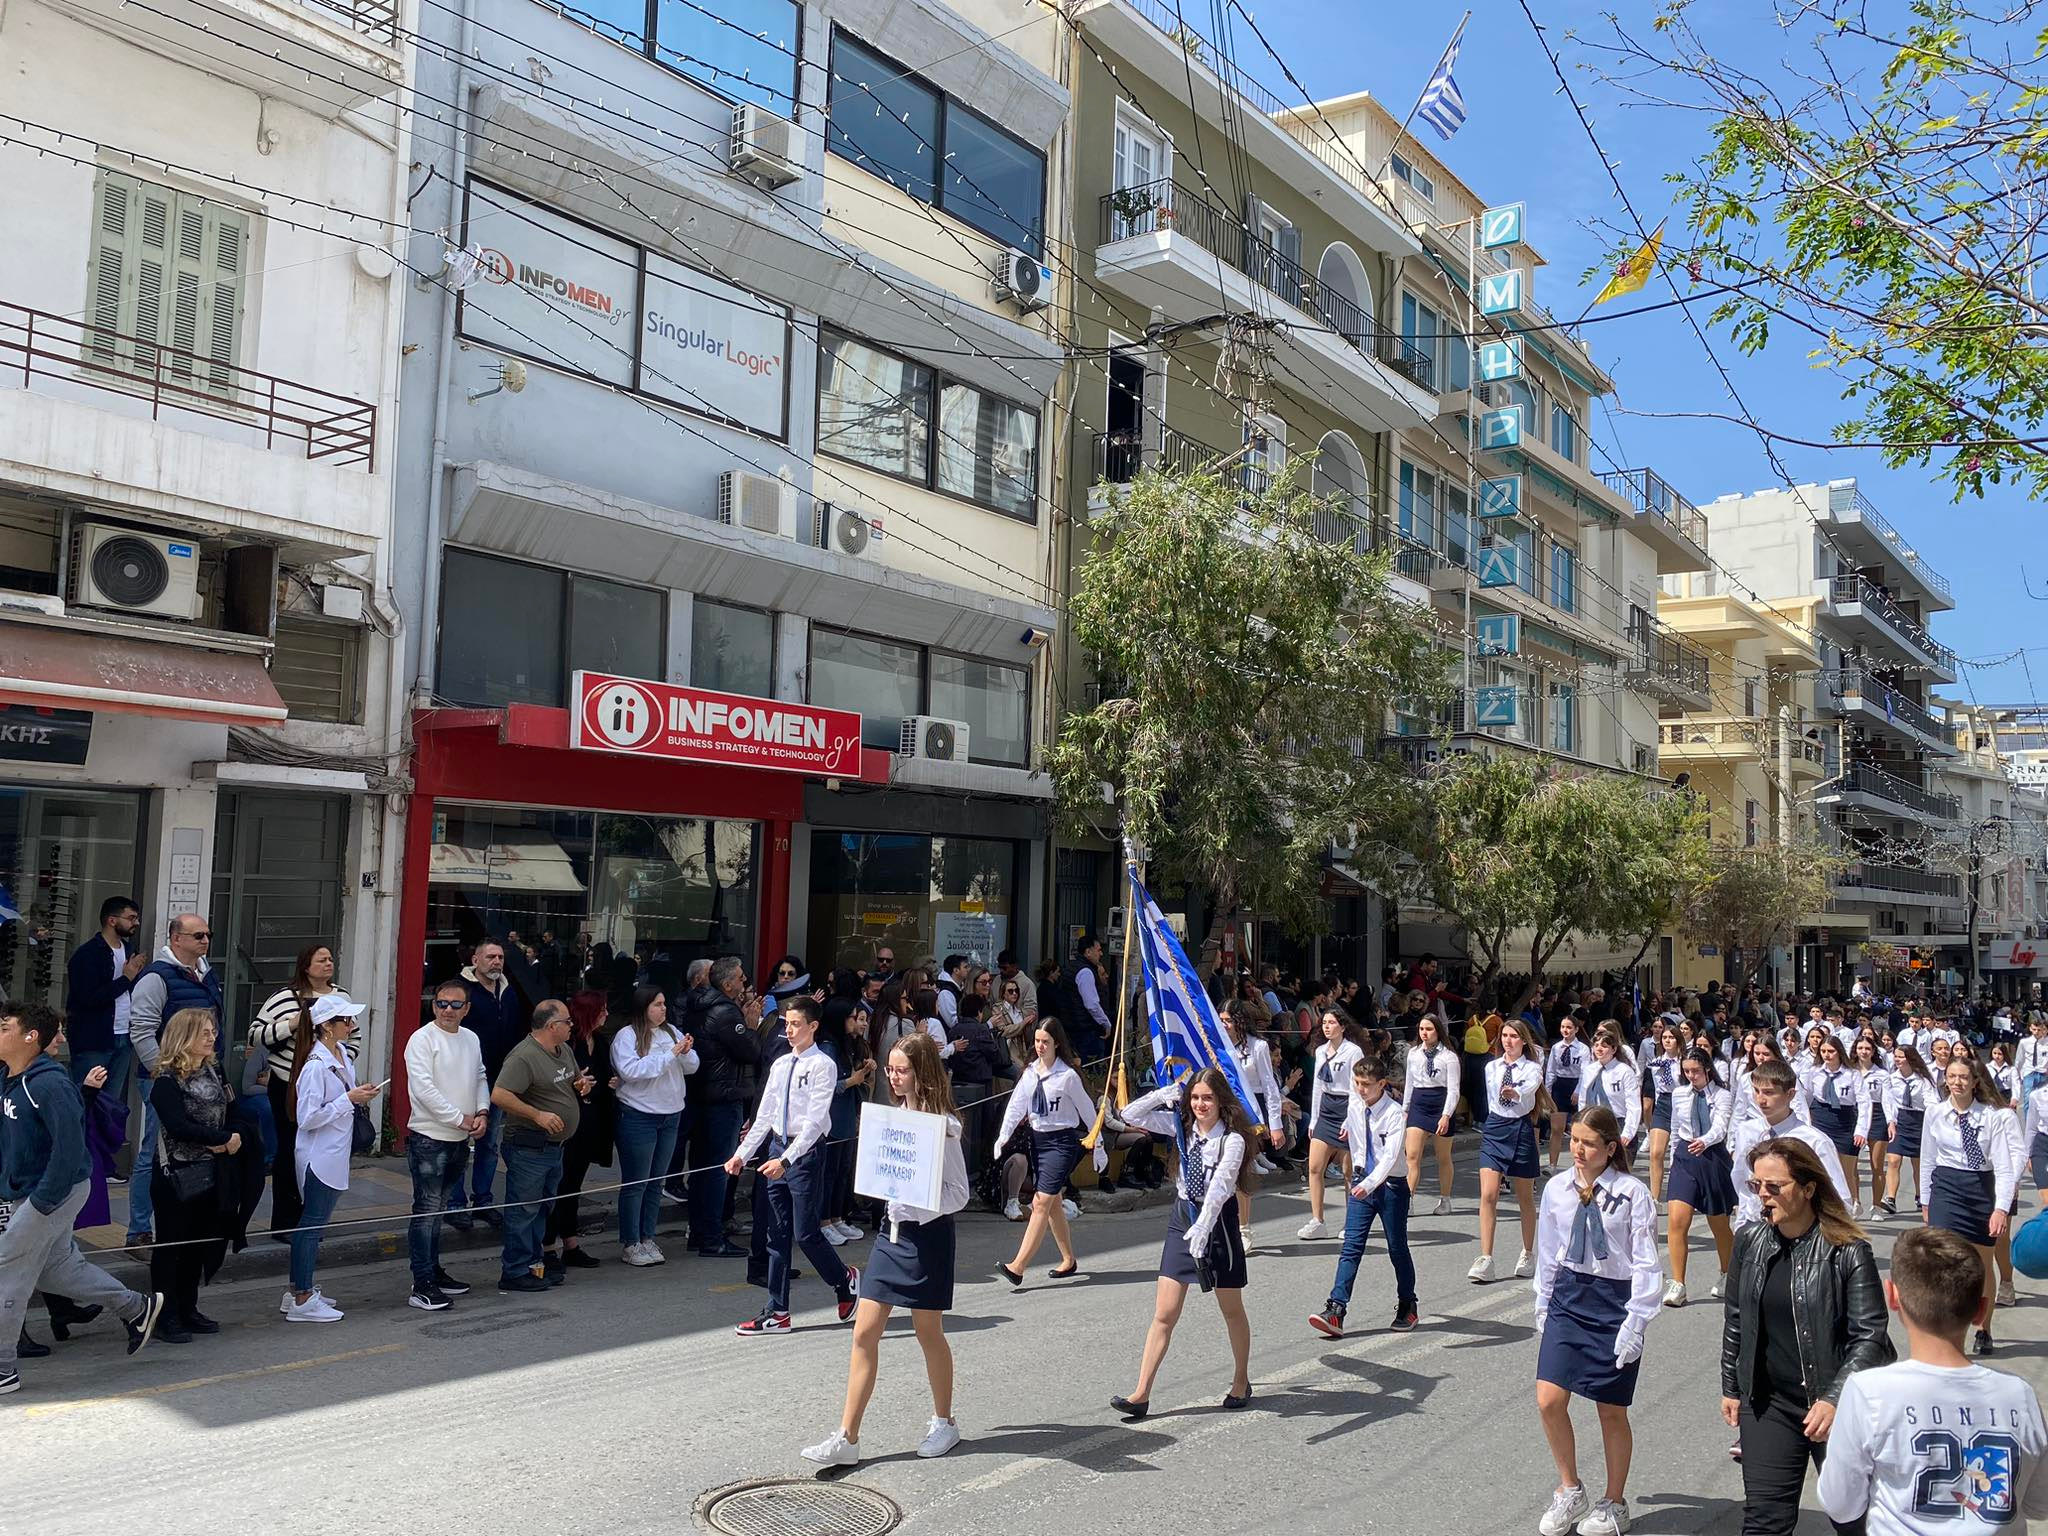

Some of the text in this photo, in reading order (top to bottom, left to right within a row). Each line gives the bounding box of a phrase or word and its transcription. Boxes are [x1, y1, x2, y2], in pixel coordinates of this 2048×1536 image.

[668, 736, 825, 762] BUSINESS STRATEGY & TECHNOLOGY
[775, 838, 788, 852] 70
[1905, 1406, 2020, 1428] SONIC
